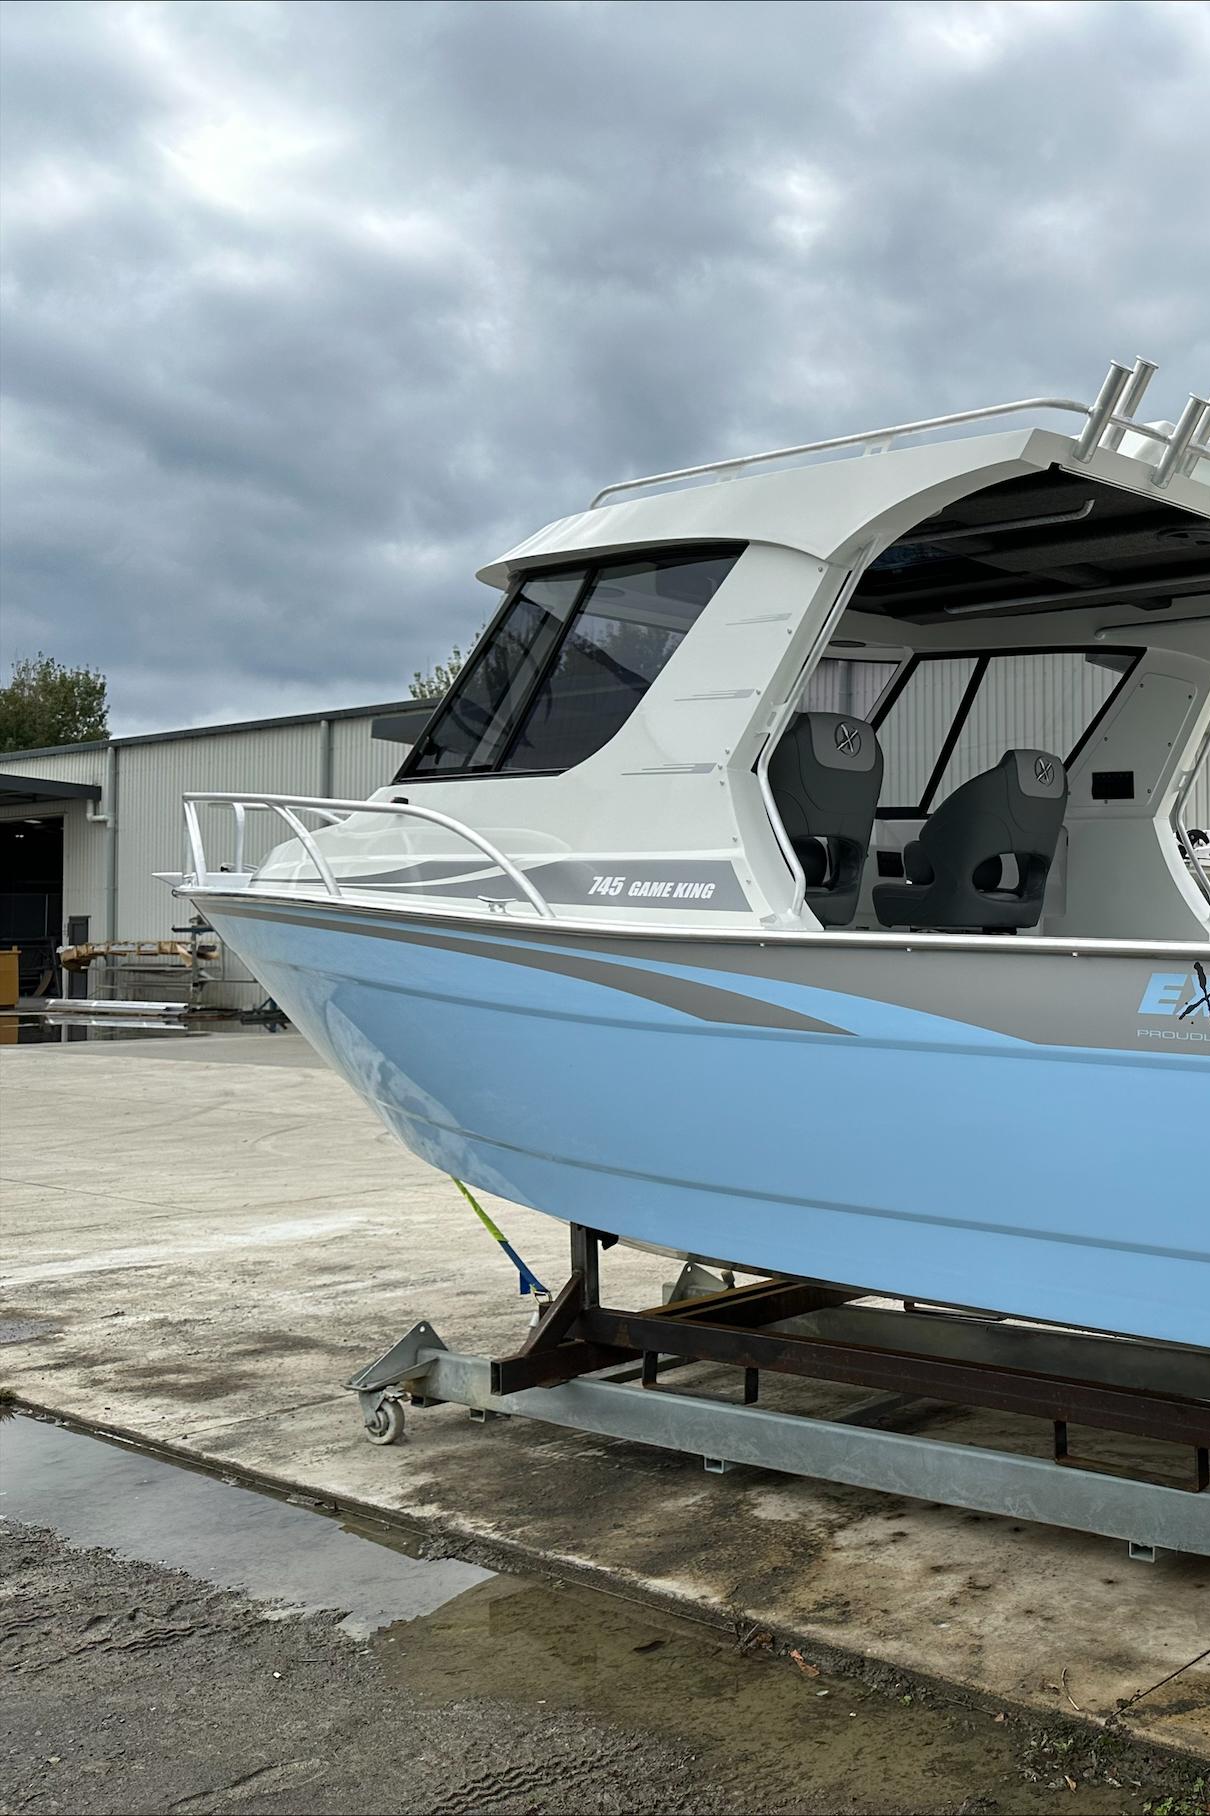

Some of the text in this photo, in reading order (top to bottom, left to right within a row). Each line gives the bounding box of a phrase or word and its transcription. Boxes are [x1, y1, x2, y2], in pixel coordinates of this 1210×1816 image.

[588, 876, 715, 899] 745 GAME KING
